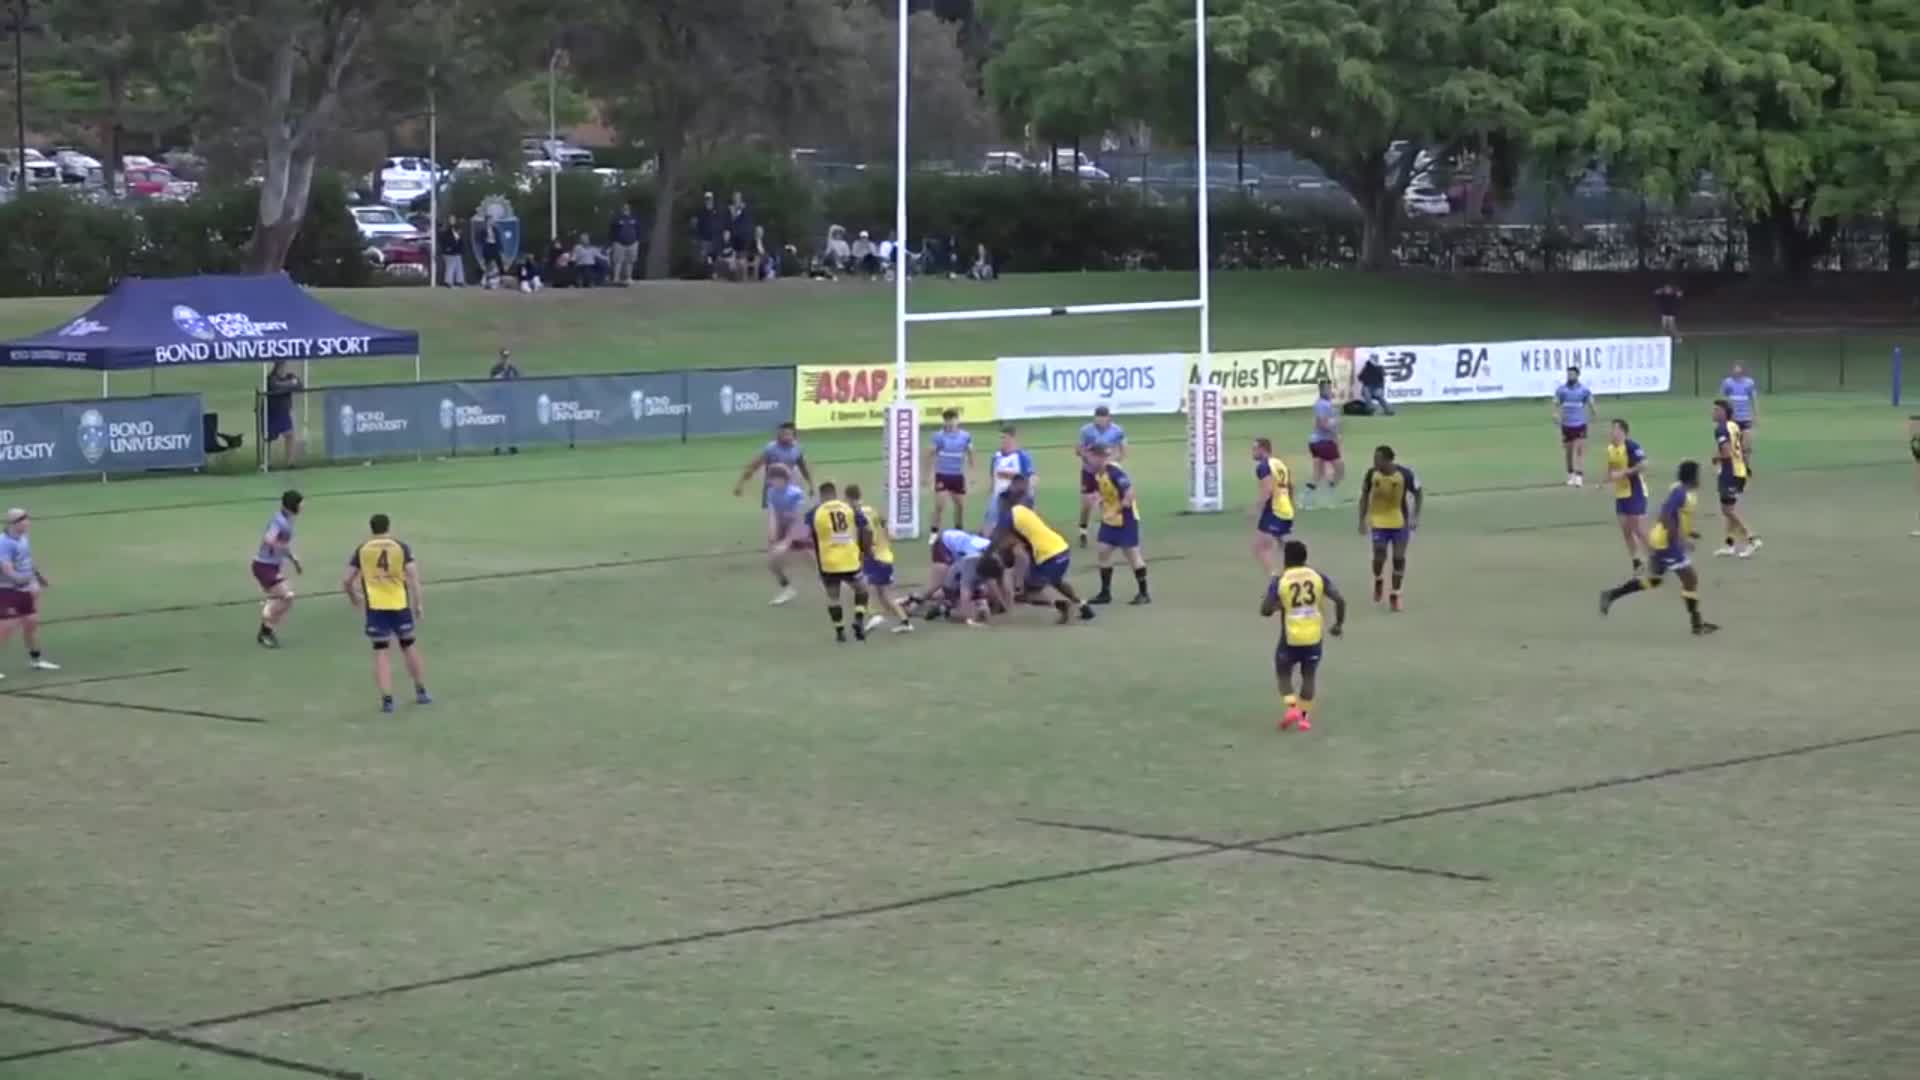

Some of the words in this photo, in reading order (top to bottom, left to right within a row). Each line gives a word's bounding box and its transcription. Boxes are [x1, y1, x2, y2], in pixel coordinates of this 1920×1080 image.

[156, 343, 209, 363] BOND
[214, 339, 313, 359] UNIVERSITY
[318, 336, 371, 355] SPORT
[1455, 348, 1489, 379] BA
[1520, 347, 1602, 373] MERRIMAC
[814, 369, 888, 404] ASAP
[1053, 365, 1155, 398] morgans
[1262, 357, 1331, 389] PIZZA
[110, 421, 154, 438] BOND
[1203, 390, 1217, 465] KENNARDS
[110, 434, 193, 453] UNIVERSITY
[897, 409, 913, 489] KENNARDS
[829, 511, 849, 532] 18
[376, 549, 389, 572] 4
[1288, 579, 1316, 608] 23
